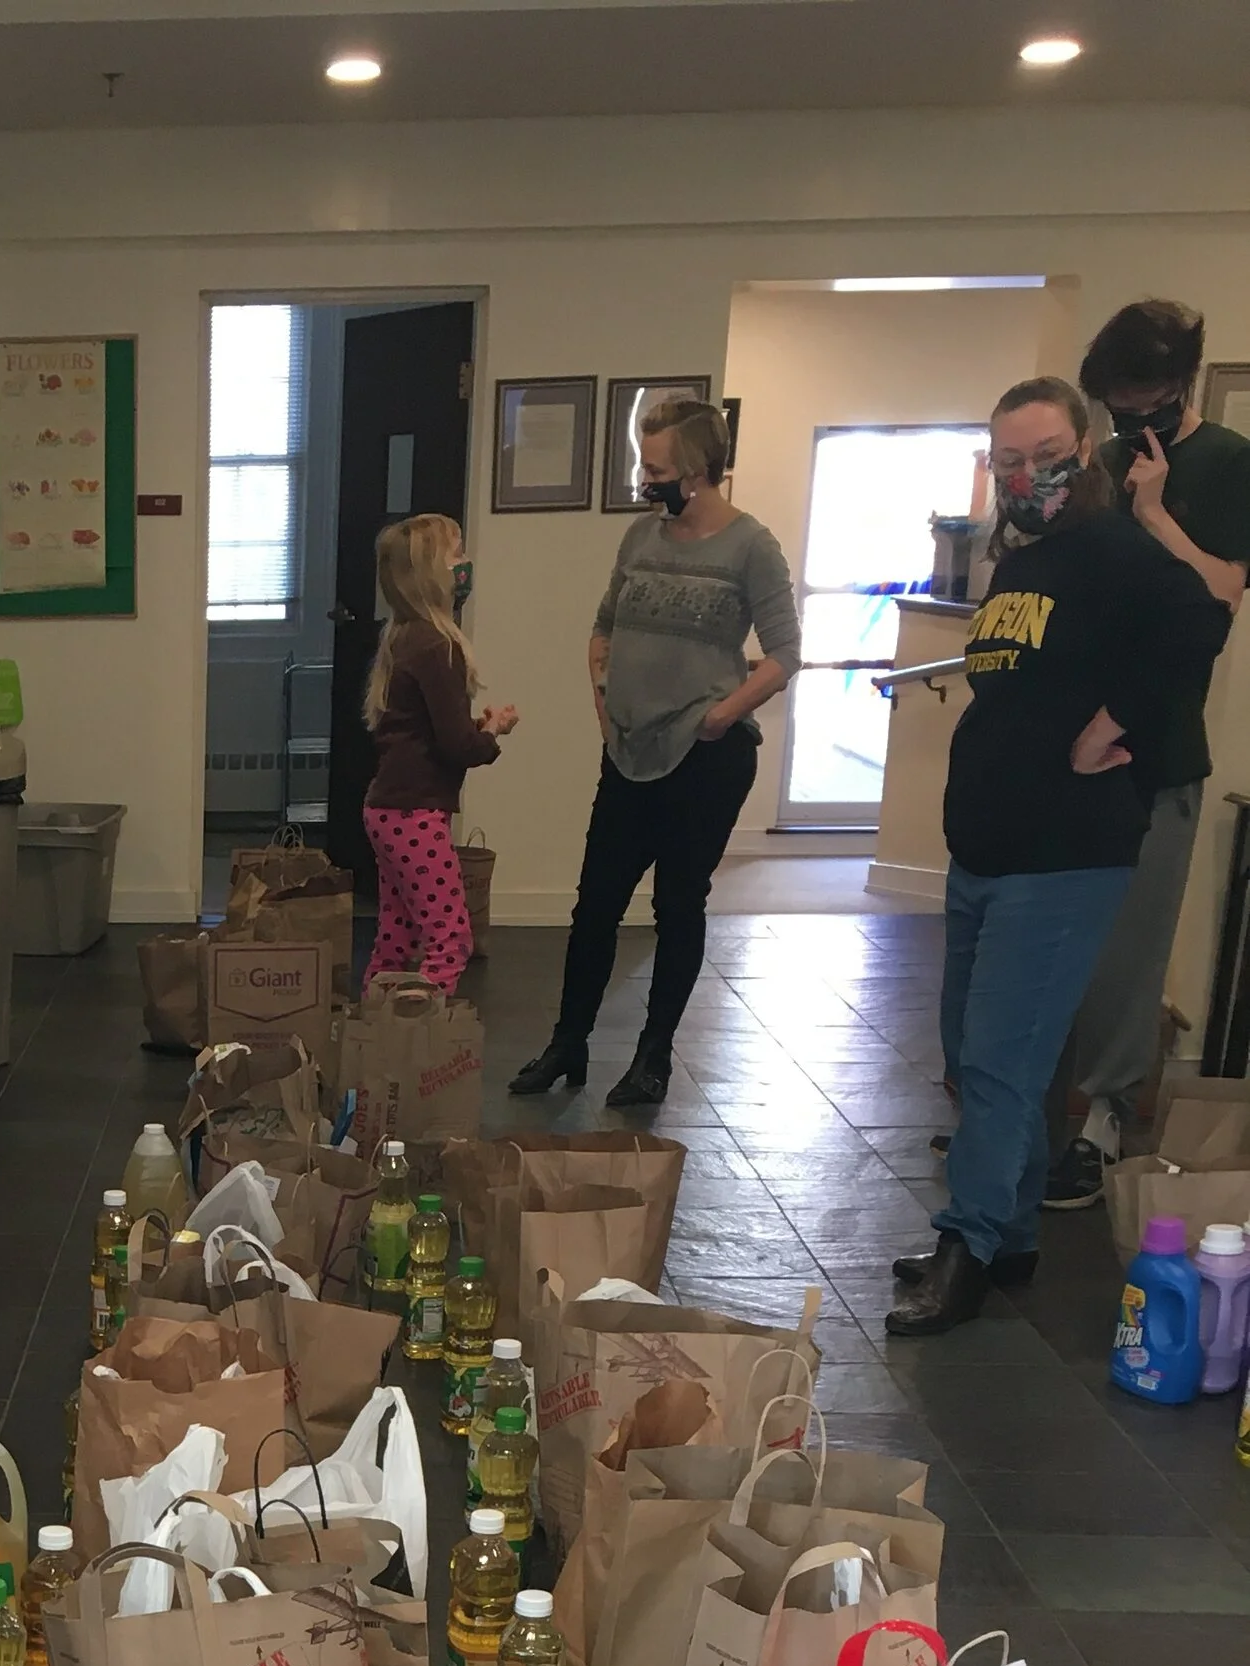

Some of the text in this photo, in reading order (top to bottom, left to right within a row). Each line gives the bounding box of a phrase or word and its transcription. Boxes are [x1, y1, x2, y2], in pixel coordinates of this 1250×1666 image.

[6, 352, 94, 372] FLOWERS
[969, 591, 1056, 650] OWSON
[249, 967, 302, 988] Giant
[1112, 1321, 1144, 1349] XTRA
